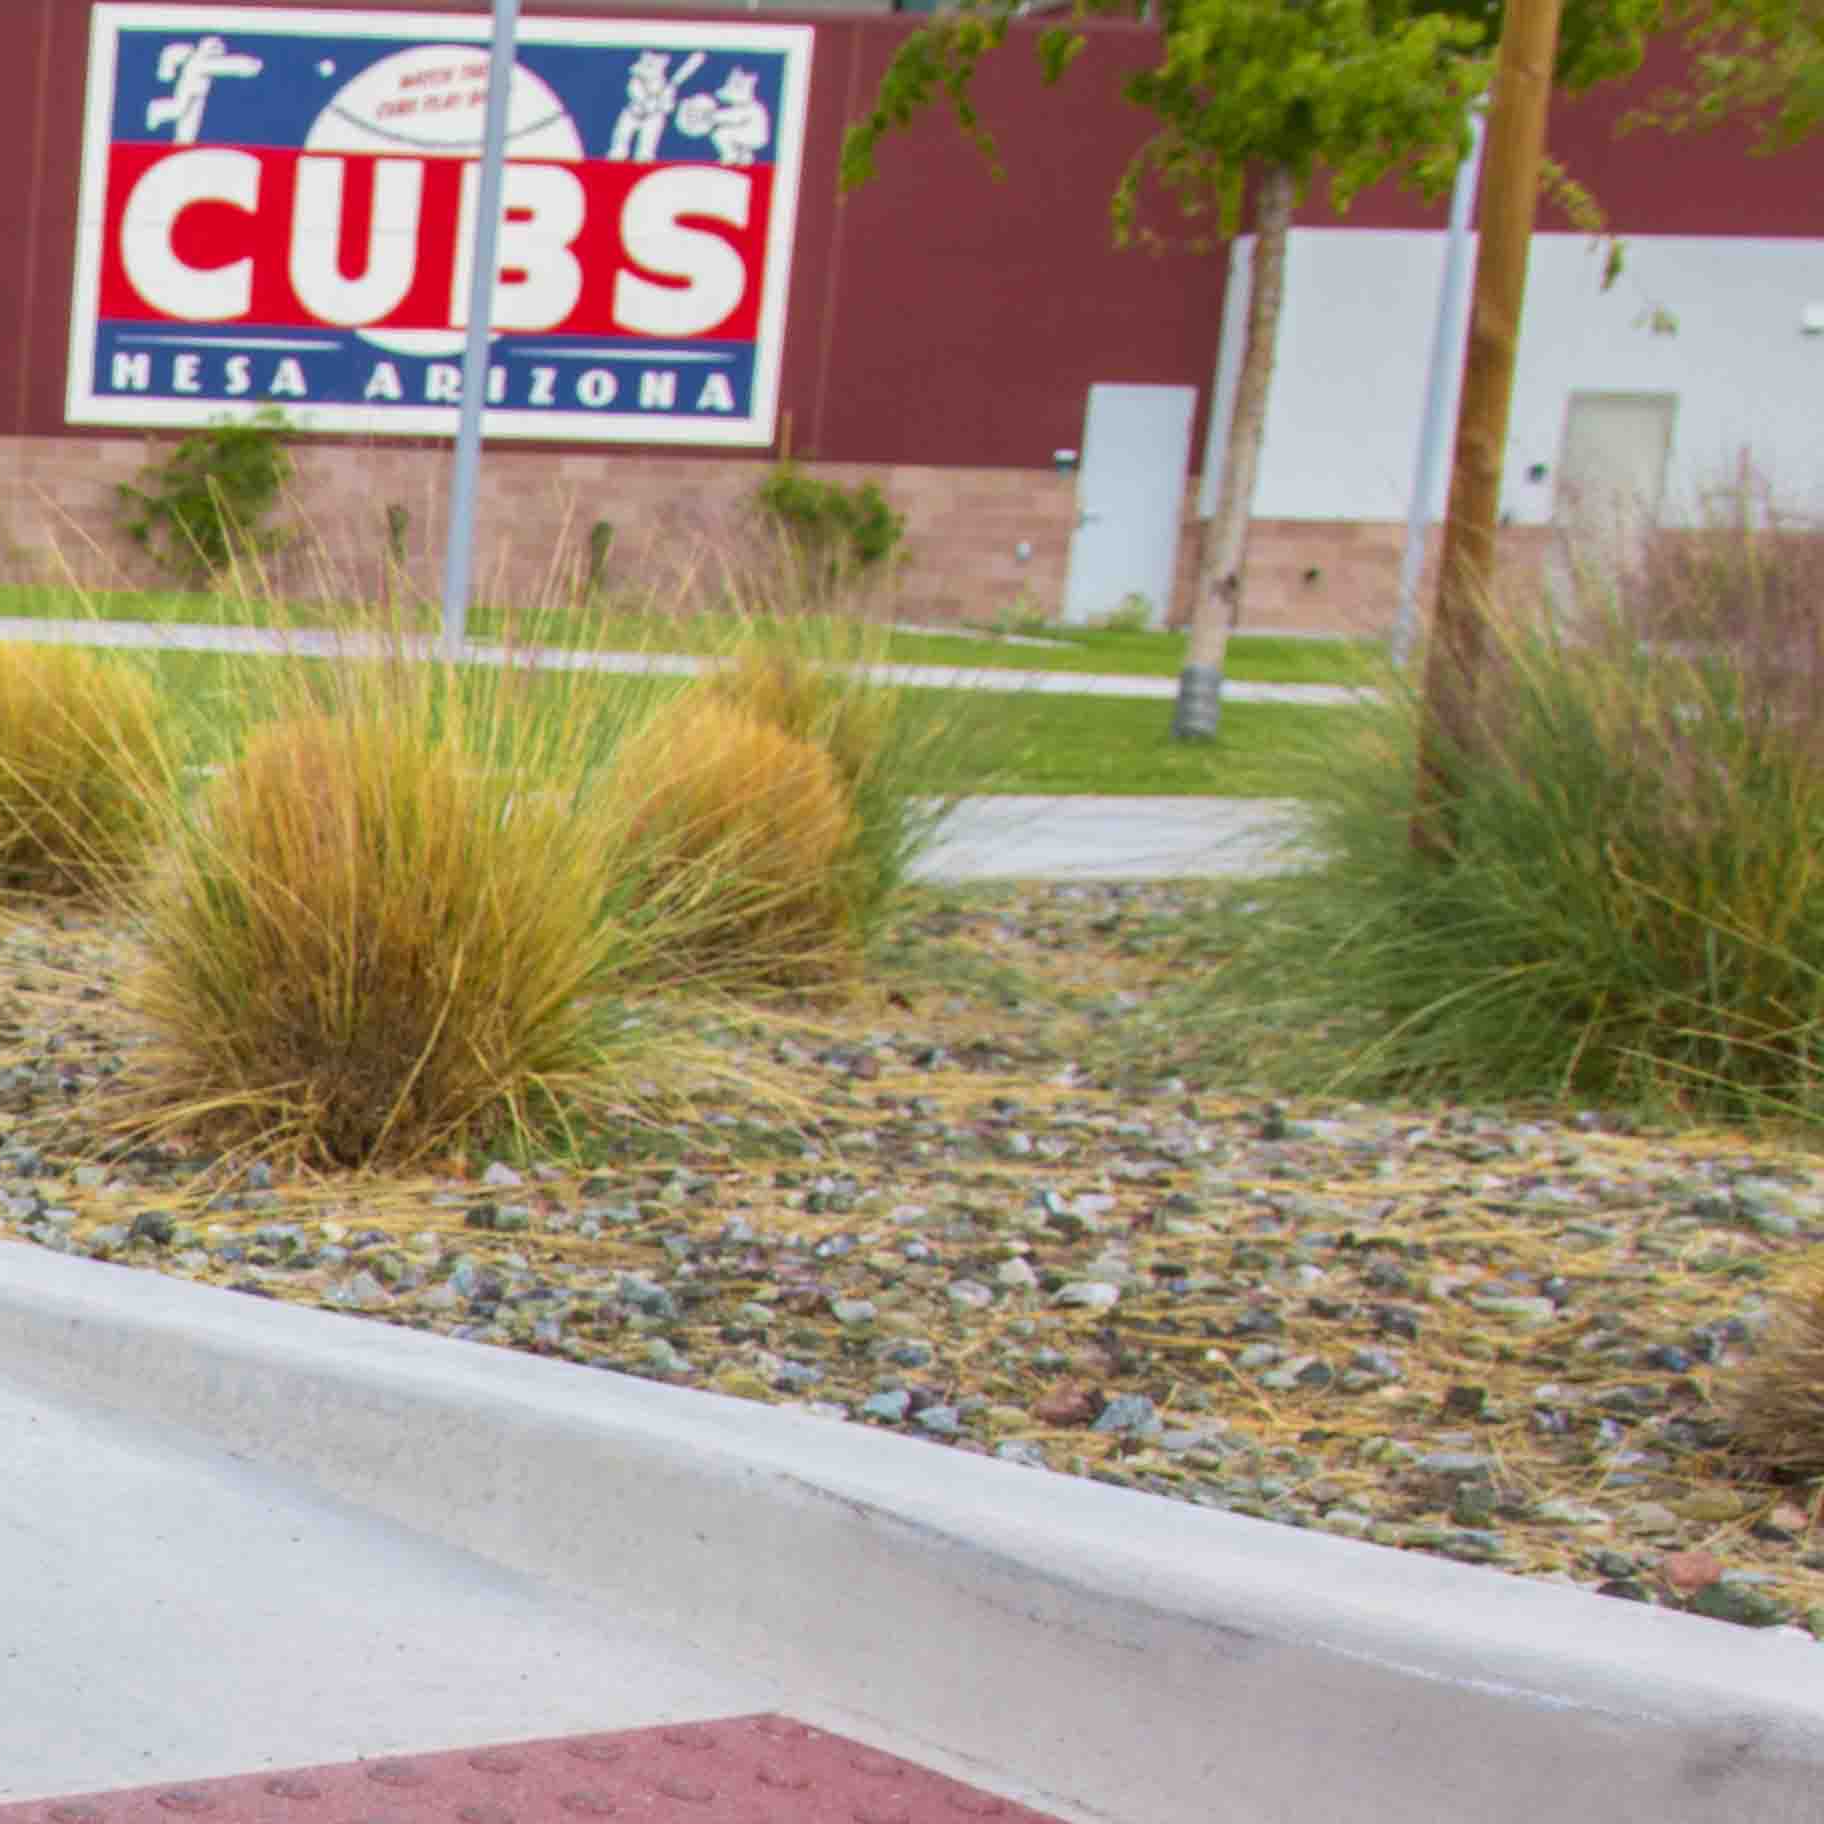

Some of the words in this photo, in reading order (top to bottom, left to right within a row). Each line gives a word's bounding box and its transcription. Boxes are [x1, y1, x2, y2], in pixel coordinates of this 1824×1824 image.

[120, 147, 751, 338] CUBS
[111, 352, 307, 396] MESA
[364, 361, 735, 412] ARIZONA
